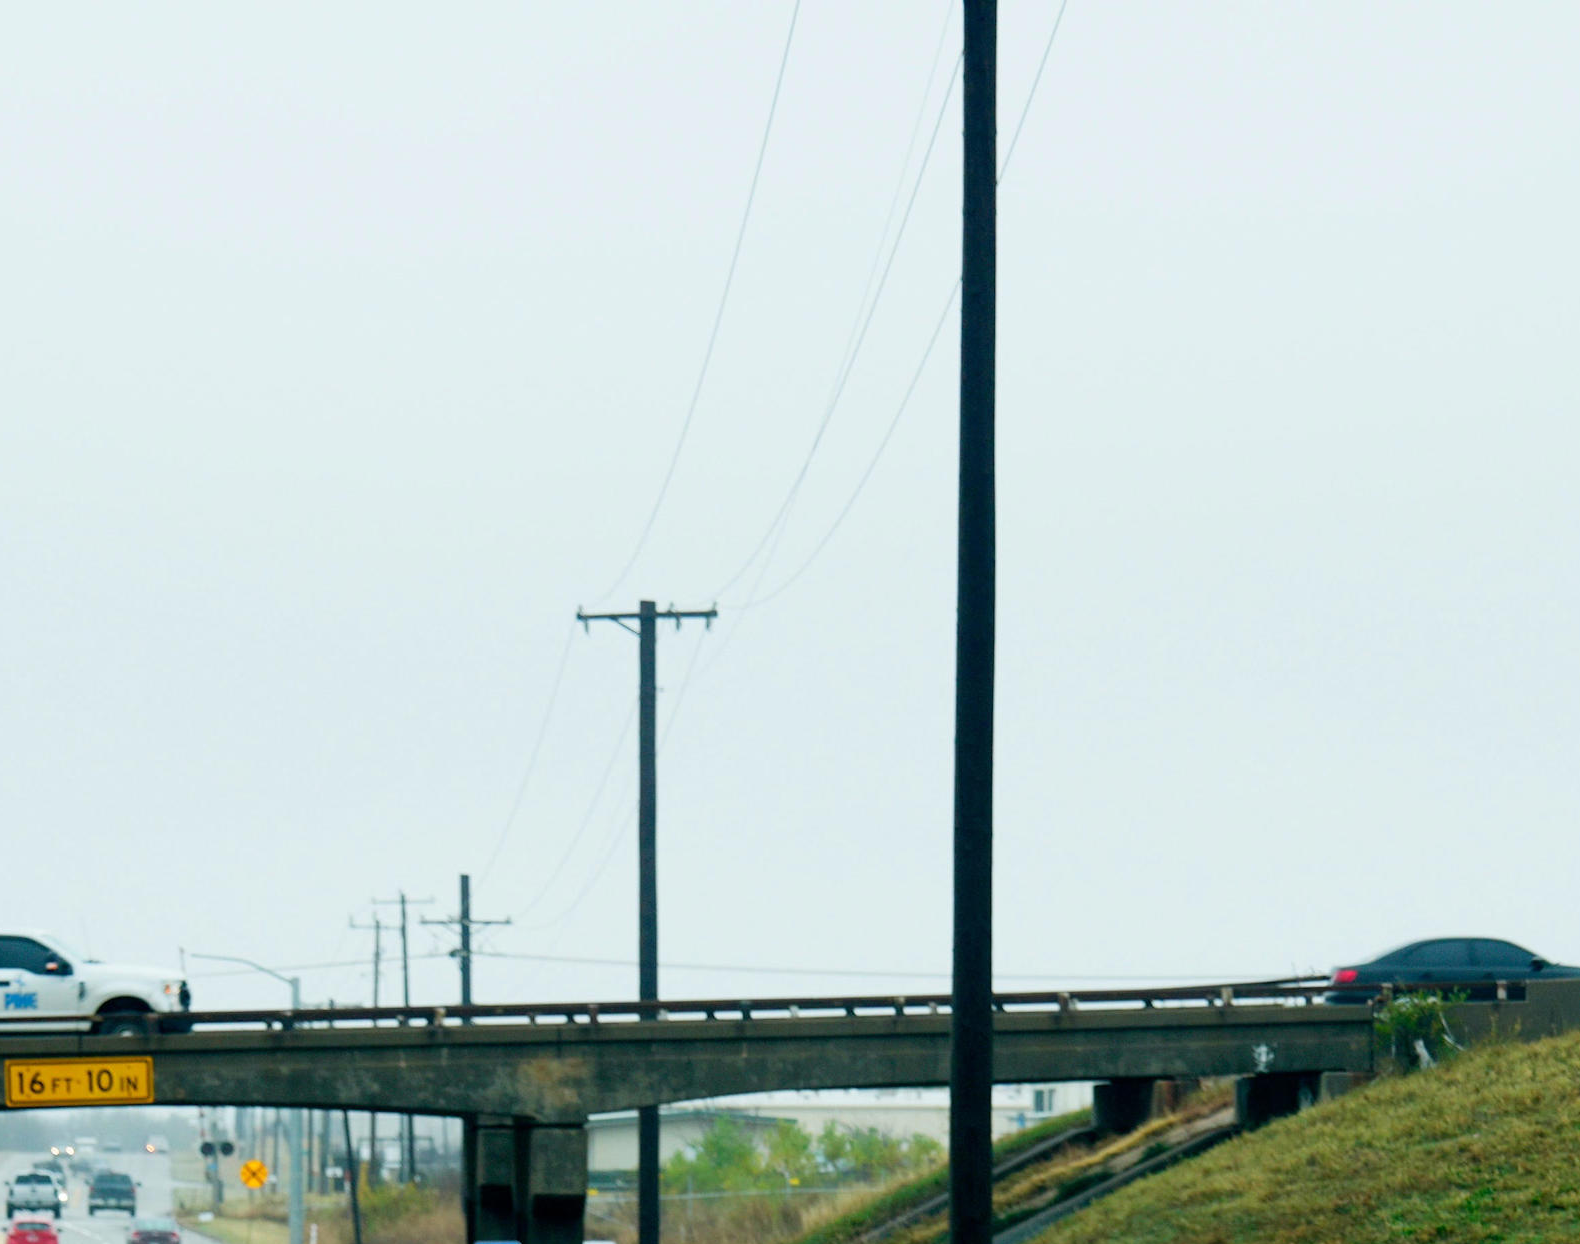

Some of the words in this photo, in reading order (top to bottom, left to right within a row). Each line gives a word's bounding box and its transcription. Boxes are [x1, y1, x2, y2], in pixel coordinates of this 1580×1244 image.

[18, 1070, 46, 1095] 16
[51, 1078, 72, 1094] FT
[86, 1068, 114, 1094] 10
[120, 1076, 139, 1093] IN
